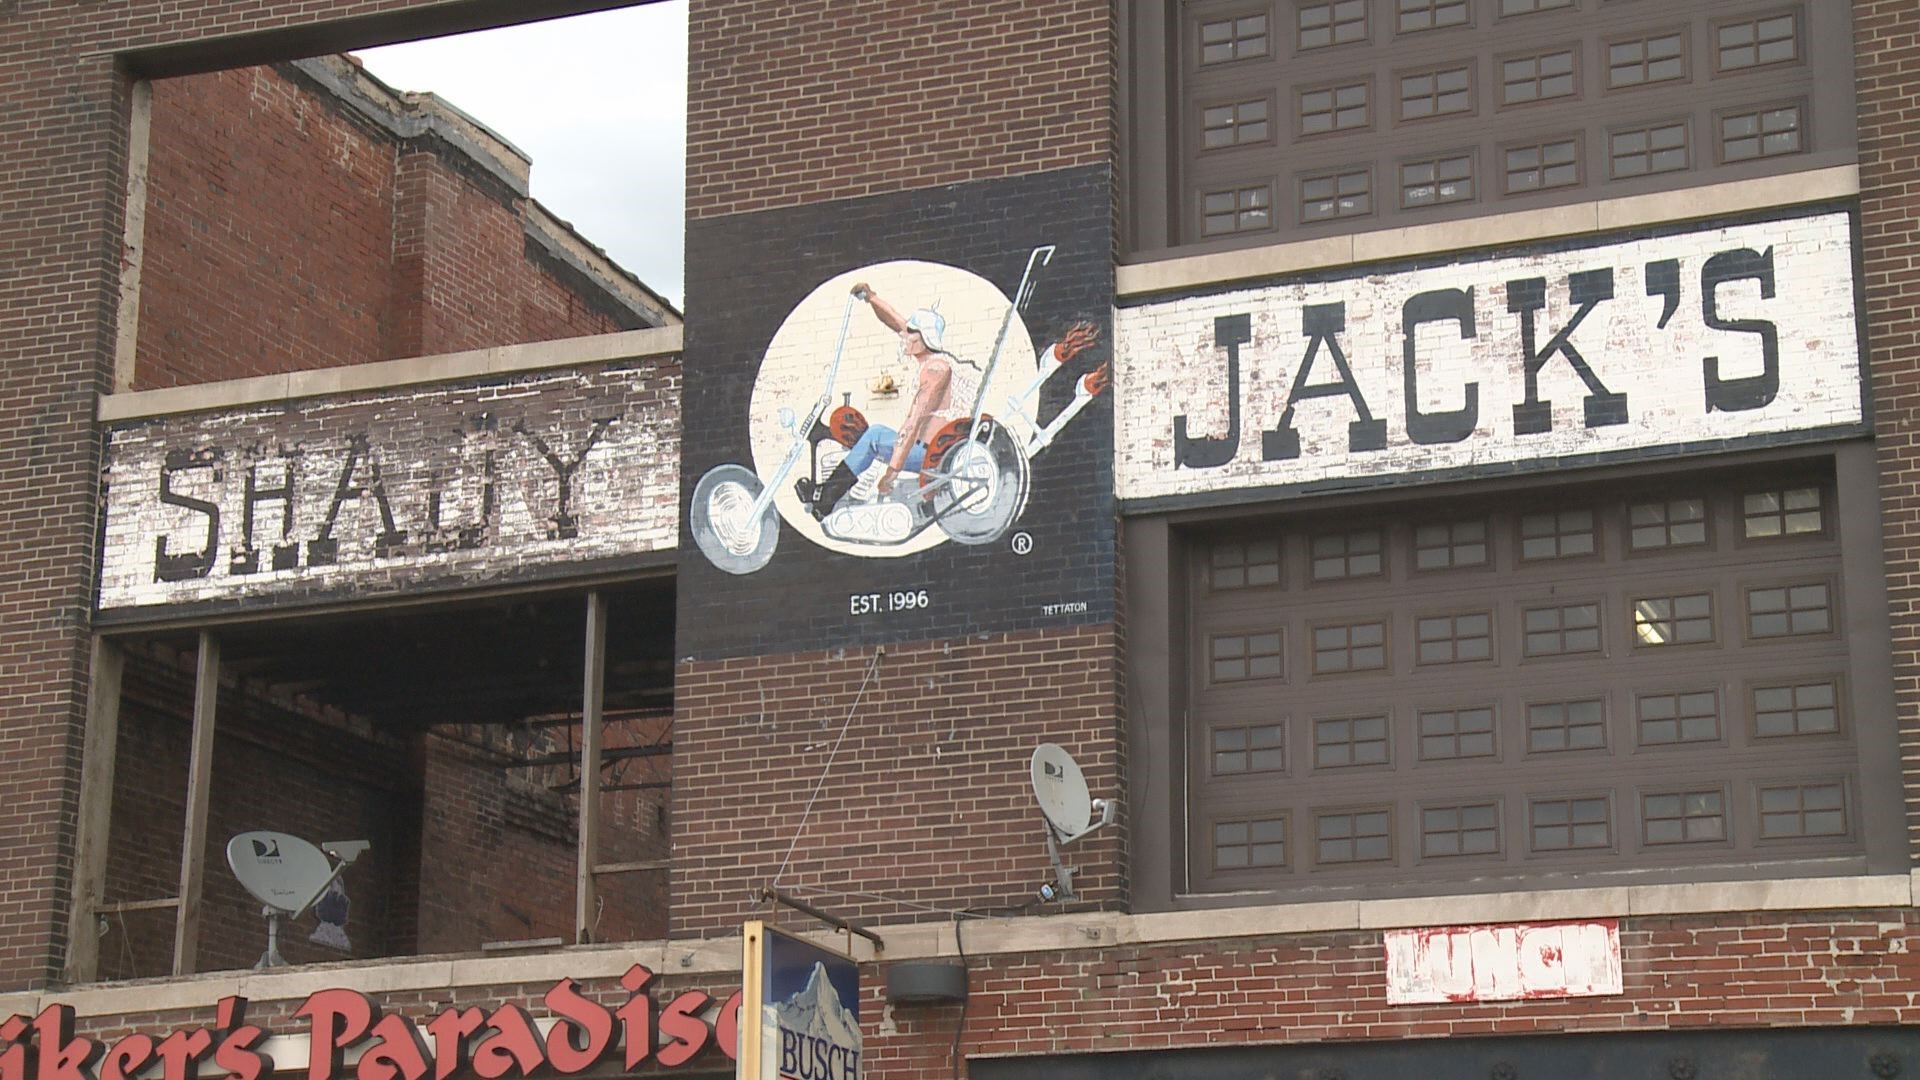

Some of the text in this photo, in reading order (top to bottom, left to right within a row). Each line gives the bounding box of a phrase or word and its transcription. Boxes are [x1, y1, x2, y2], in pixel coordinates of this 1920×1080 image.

[1174, 247, 1780, 470] JACK'S
[851, 590, 929, 615] EST. 1996
[1043, 602, 1087, 616] TETTATON
[0, 996, 262, 1080] iker's
[780, 1026, 860, 1080] BUSCH
